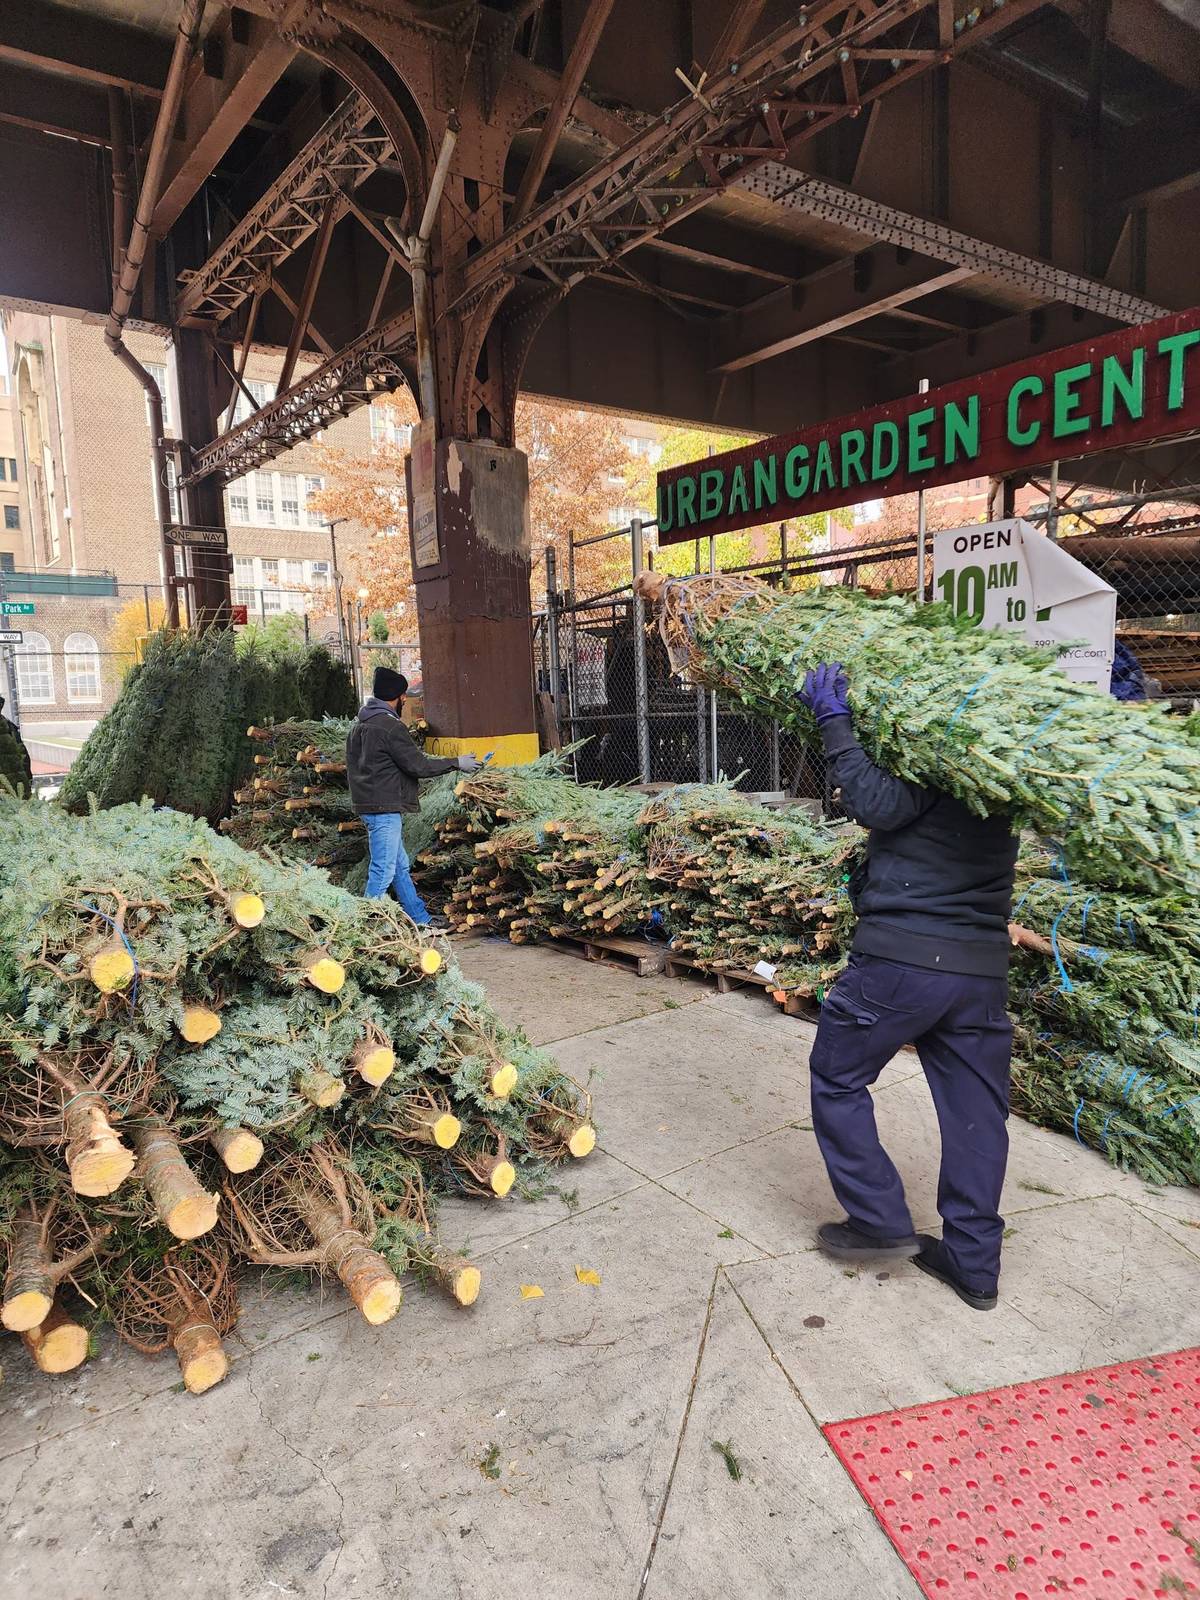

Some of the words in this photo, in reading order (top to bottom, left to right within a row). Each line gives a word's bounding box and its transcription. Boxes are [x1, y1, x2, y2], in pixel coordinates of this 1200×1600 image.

[1007, 330, 1200, 447] CENT
[170, 530, 191, 539] ONE
[202, 532, 222, 542] WAY
[953, 529, 1012, 554] OPEN
[5, 604, 22, 613] Park
[1006, 597, 1026, 622] to
